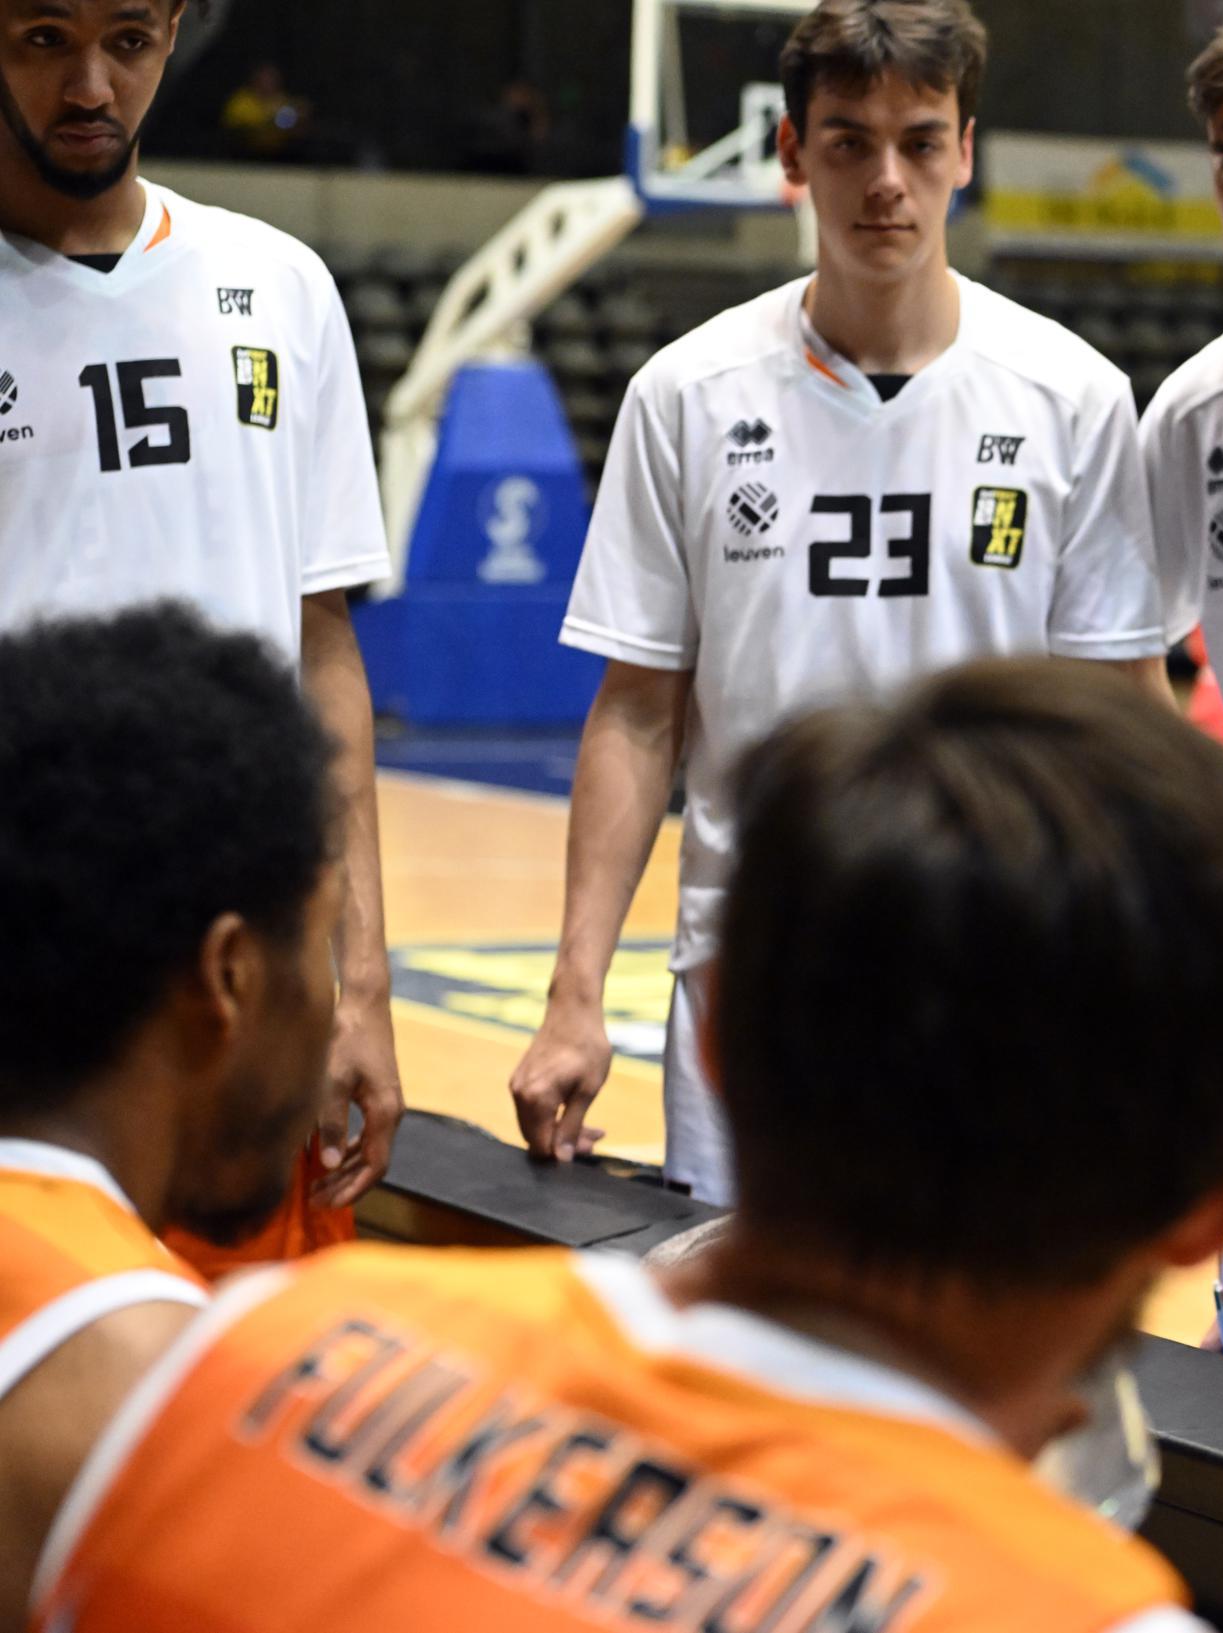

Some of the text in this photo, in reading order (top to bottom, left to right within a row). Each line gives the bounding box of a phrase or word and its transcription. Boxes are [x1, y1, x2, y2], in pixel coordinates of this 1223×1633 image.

[79, 358, 191, 473] 15
[723, 544, 785, 563] leuven
[808, 493, 932, 597] 23
[233, 1316, 932, 1633] FULKERSON
